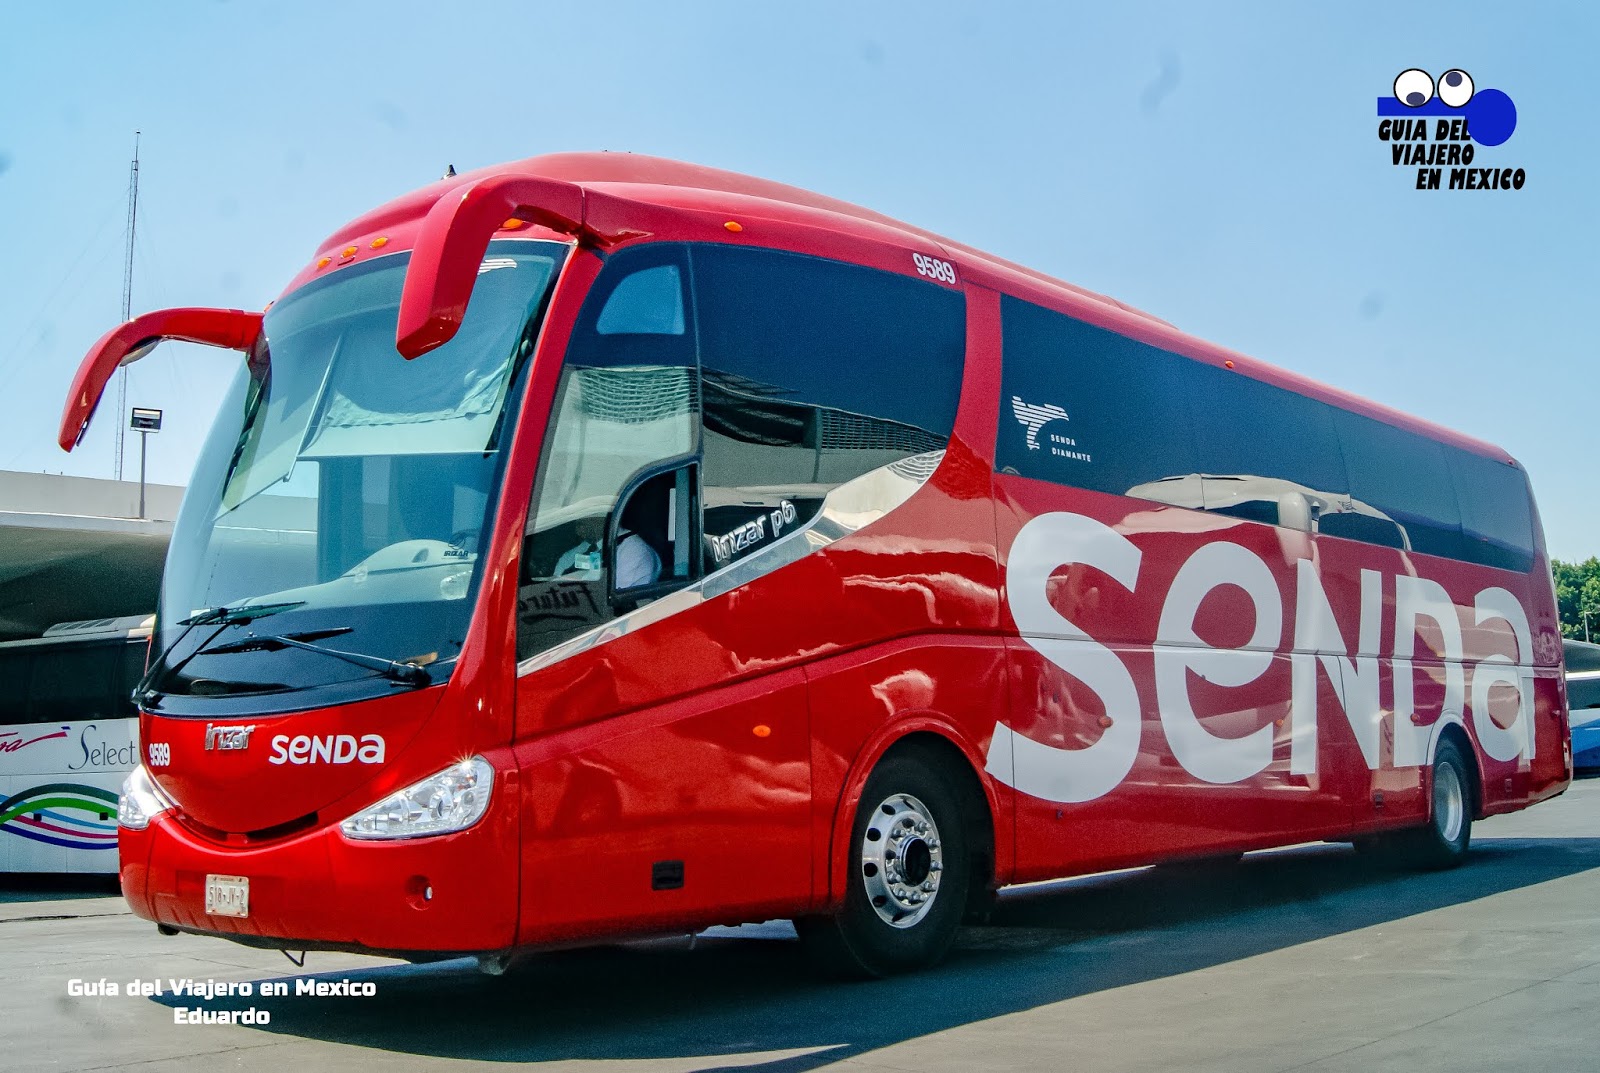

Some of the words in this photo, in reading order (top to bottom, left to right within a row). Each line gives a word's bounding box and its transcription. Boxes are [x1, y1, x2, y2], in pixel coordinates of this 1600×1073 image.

[912, 252, 956, 285] 9589
[1050, 434, 1076, 446] SENDA
[1051, 447, 1091, 462] DIAMANTE
[68, 724, 136, 770] Select
[149, 742, 171, 767] 9589
